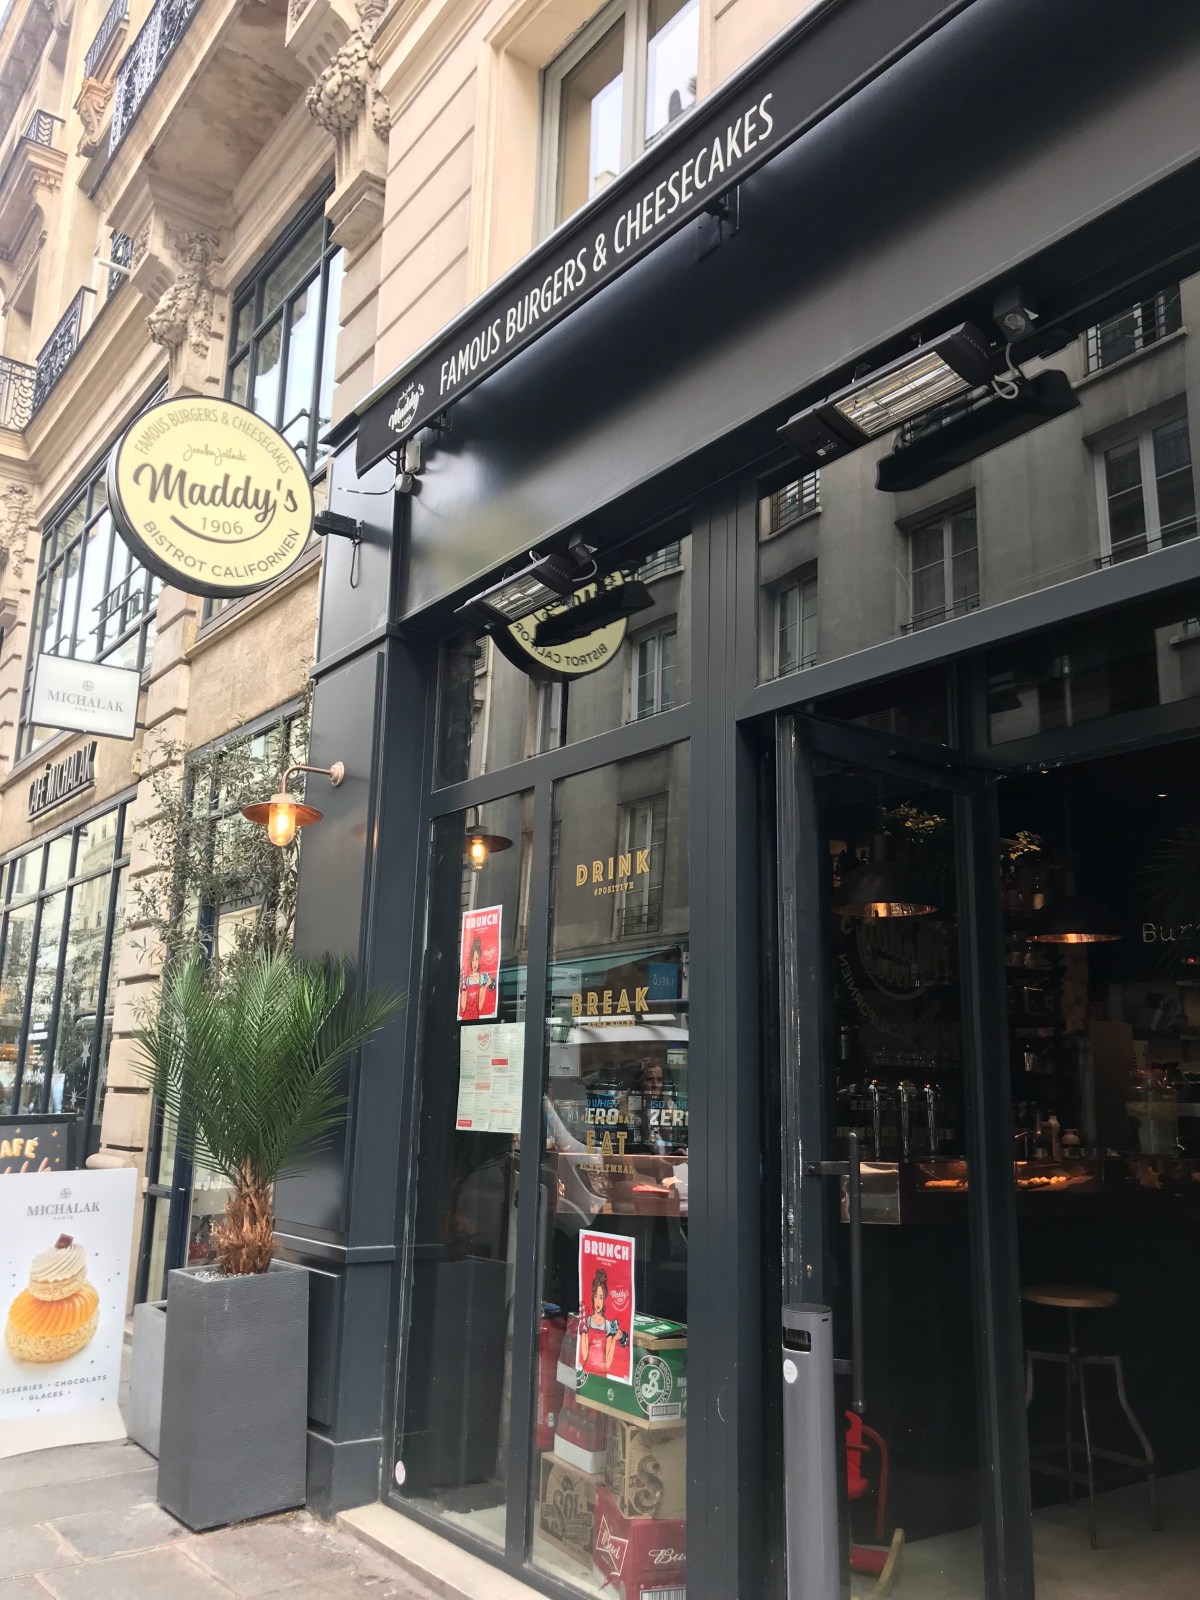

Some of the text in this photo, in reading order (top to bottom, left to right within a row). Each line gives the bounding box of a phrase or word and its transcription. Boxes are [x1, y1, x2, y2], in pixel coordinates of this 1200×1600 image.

[439, 93, 774, 395] FAMOUS BURGERS & CHEESECAKES
[134, 407, 294, 474] FAMOUS BURGERS & CHEESECAKES
[132, 462, 299, 524] Maddy's
[200, 516, 244, 536] 1906
[143, 520, 300, 579] BISTROT CALIFORNIEN
[47, 689, 124, 713] MICHALAK
[575, 848, 650, 887] DRINK
[593, 881, 635, 896] #POSITIVE
[465, 913, 498, 930] BRUNCH
[571, 986, 650, 1017] BREAK
[0, 1136, 39, 1159] AFÉ
[586, 1129, 628, 1157] EAT
[26, 1201, 101, 1217] MICHALAK
[583, 1239, 629, 1261] BRUNCH
[0, 1374, 108, 1395] ISSERIES CHOCOLATS
[28, 1390, 64, 1402] GLACES
[648, 1548, 687, 1565] Bu
